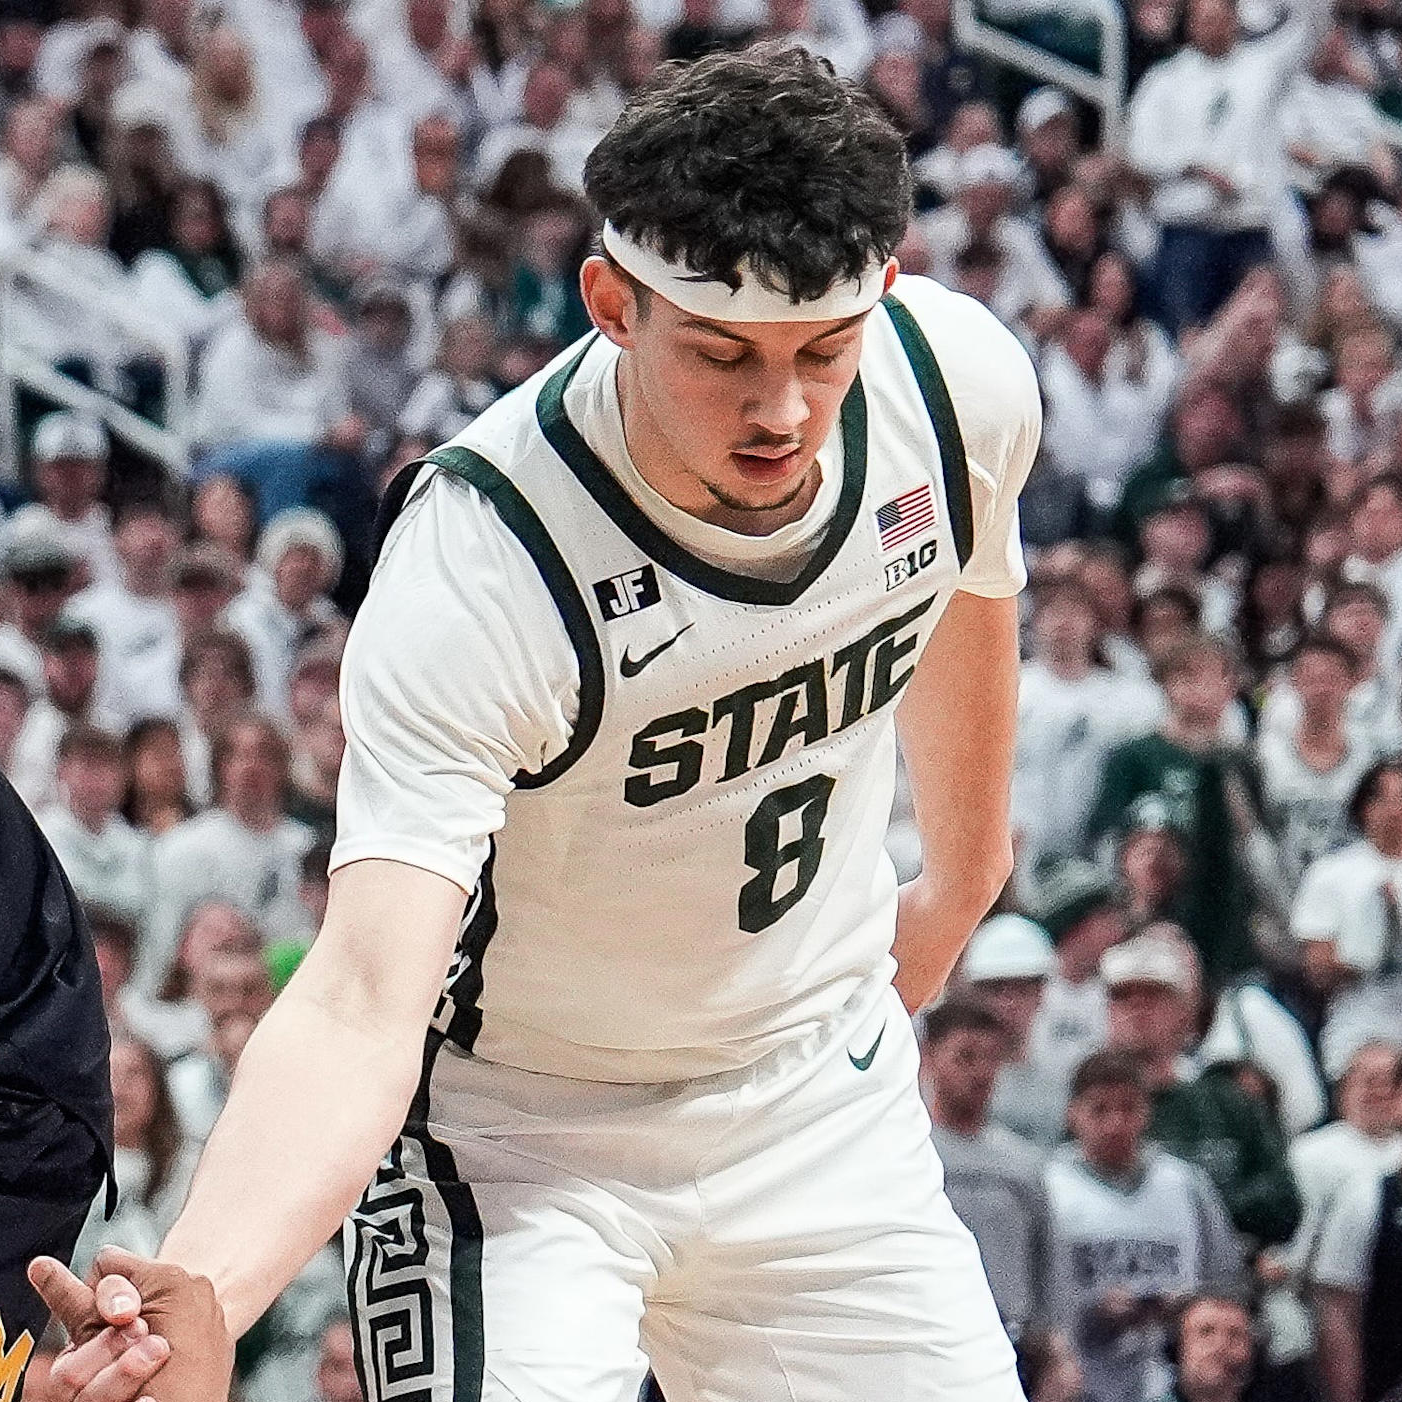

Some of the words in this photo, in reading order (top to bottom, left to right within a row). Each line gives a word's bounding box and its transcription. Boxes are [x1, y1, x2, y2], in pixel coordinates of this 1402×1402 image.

[609, 569, 645, 616] JF
[624, 590, 939, 808] STATE
[738, 773, 836, 934] 8
